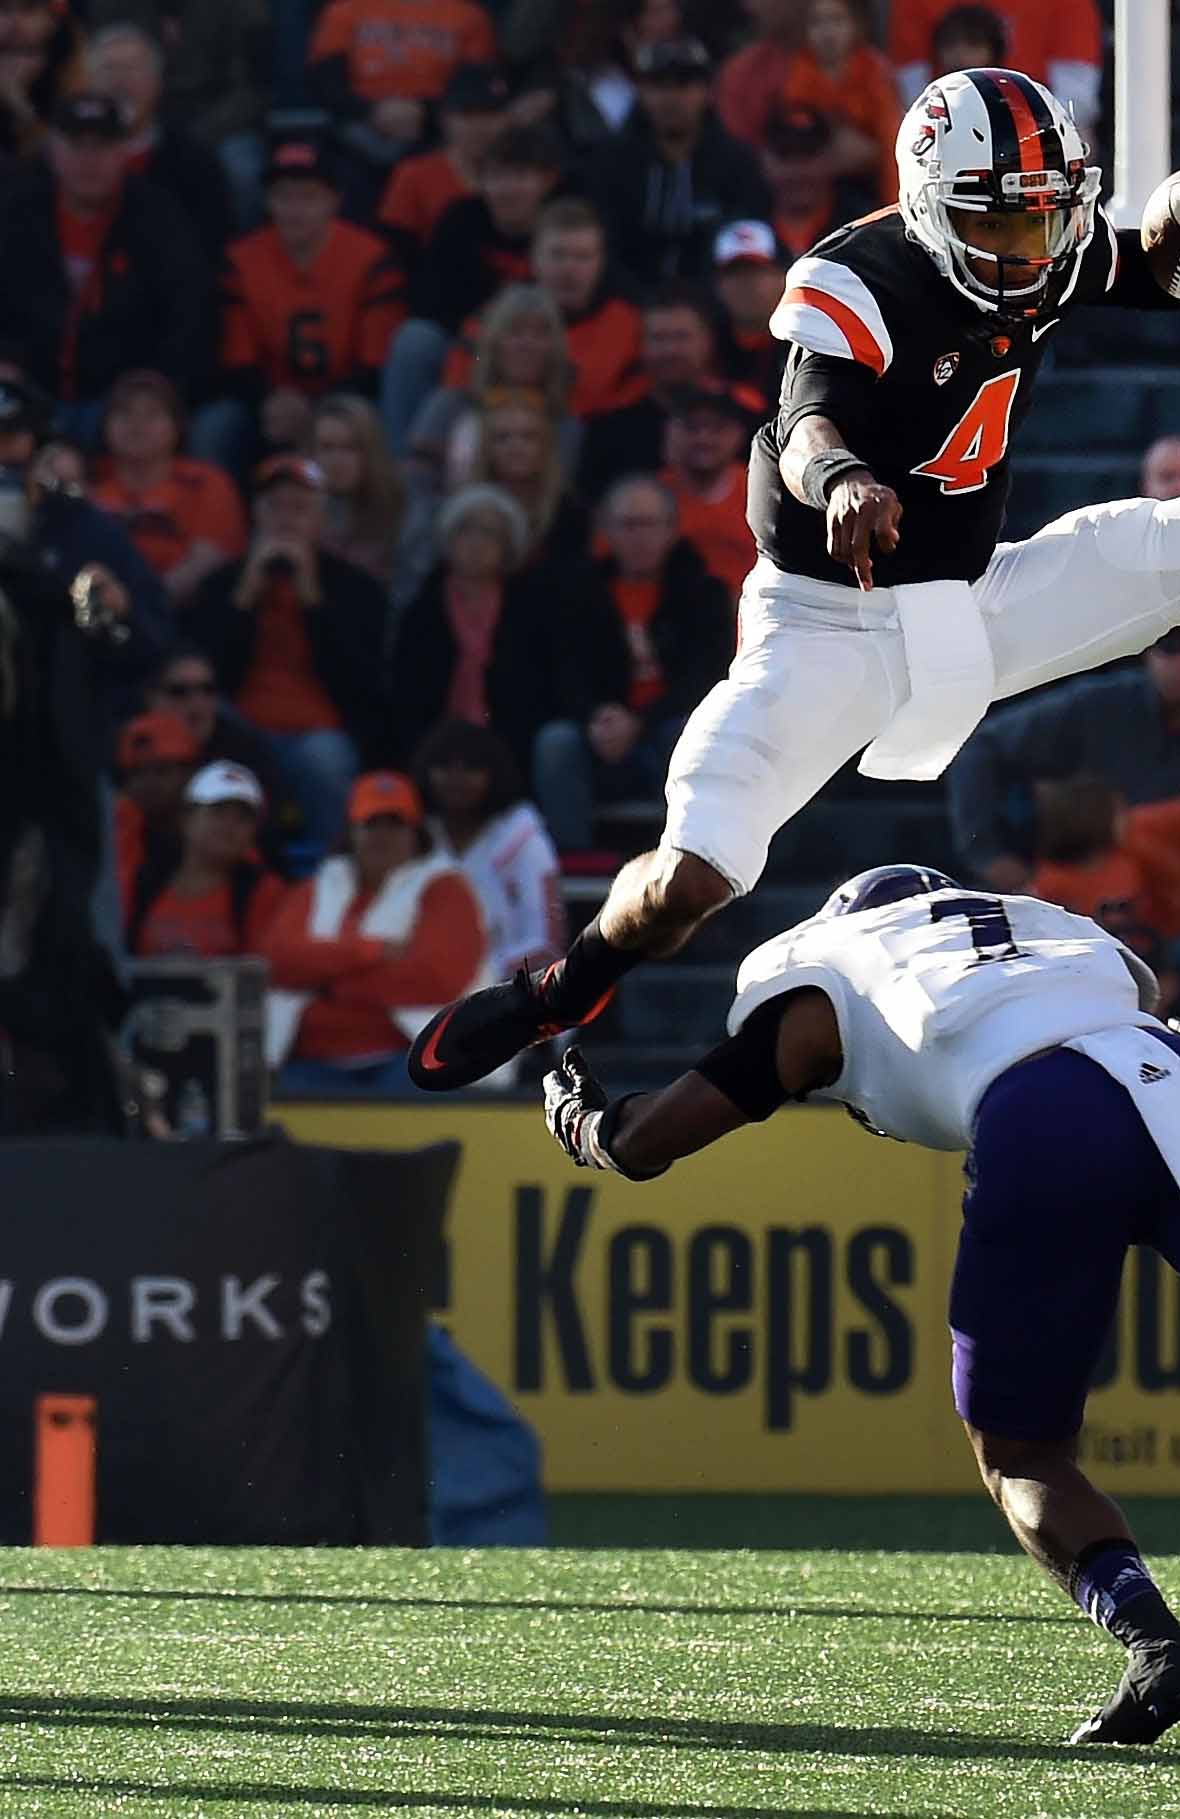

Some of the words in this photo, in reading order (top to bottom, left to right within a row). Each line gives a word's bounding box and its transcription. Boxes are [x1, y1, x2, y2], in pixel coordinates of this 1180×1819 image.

[909, 367, 1022, 496] 4
[0, 1271, 332, 1346] ORKS
[513, 1184, 915, 1432] Keeps
